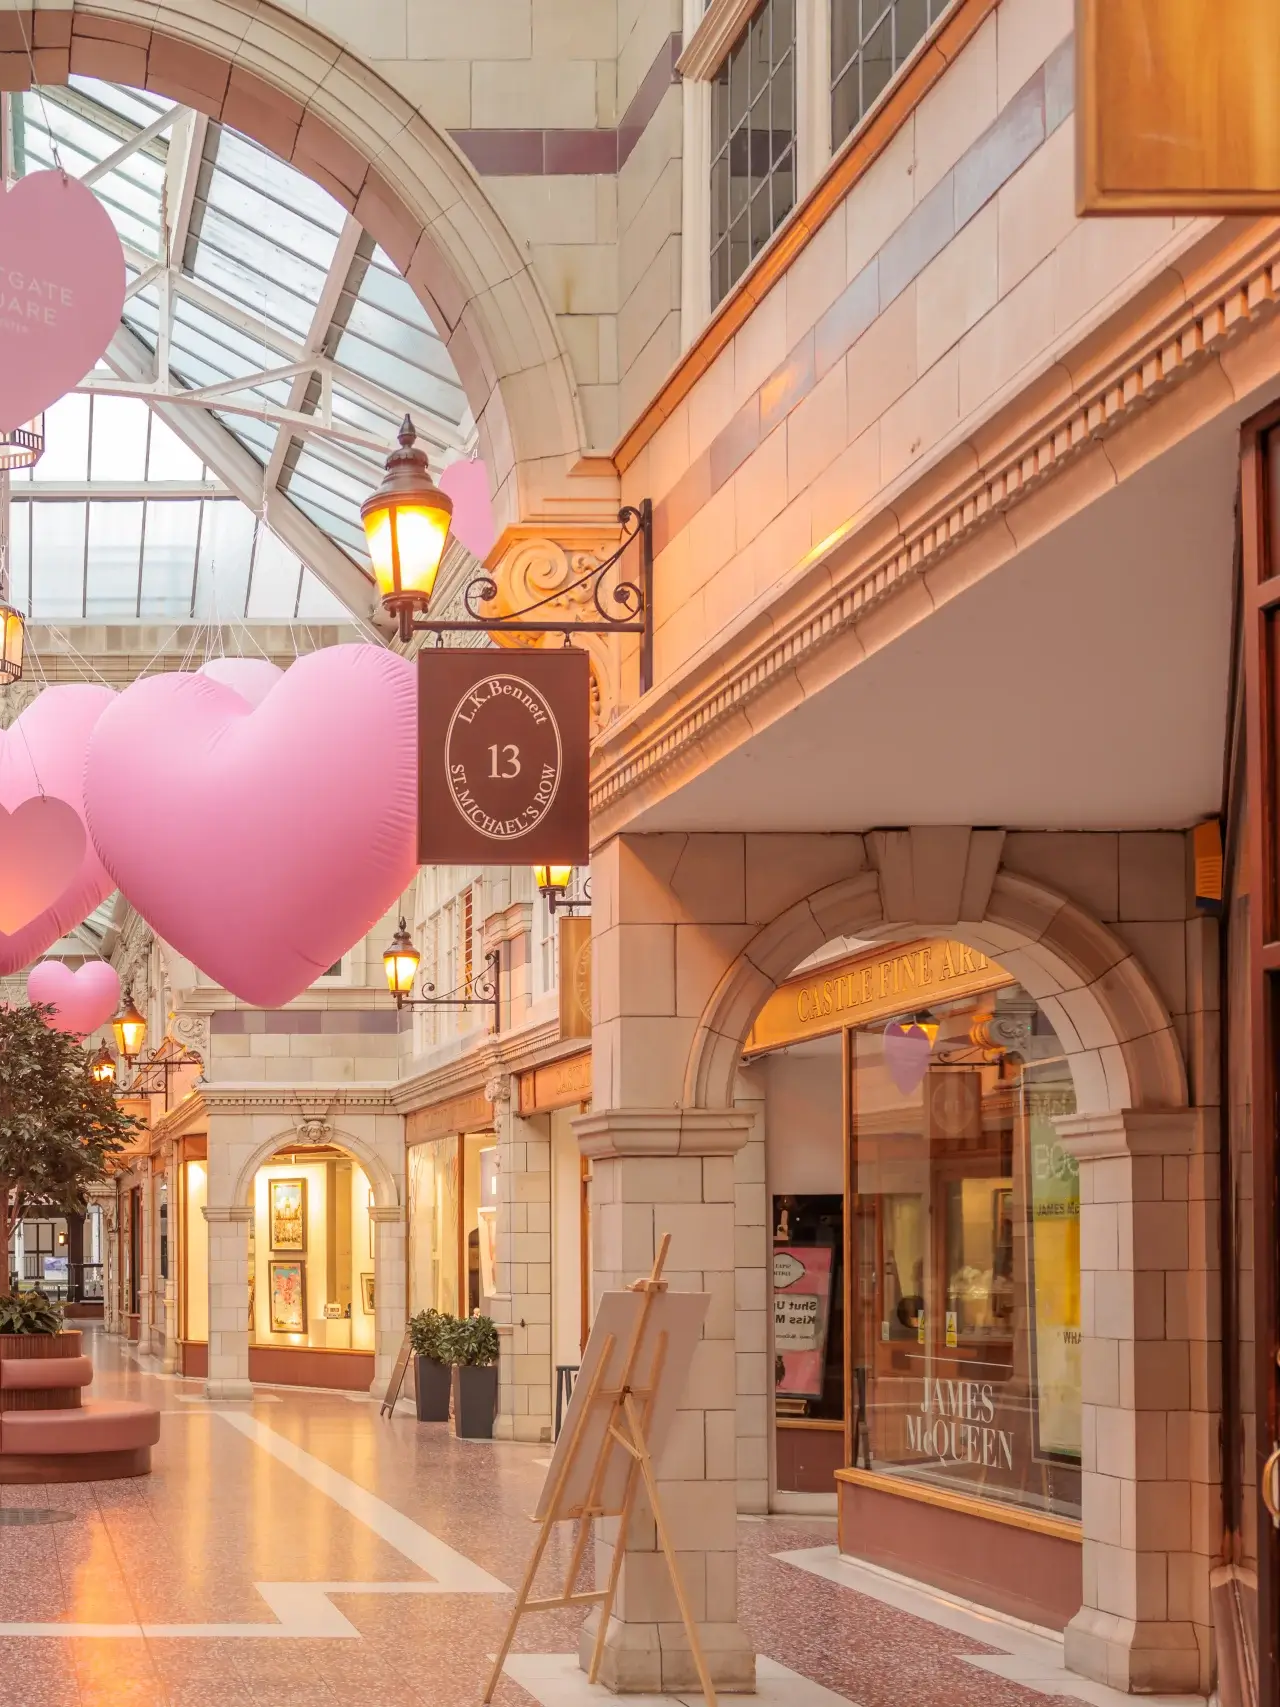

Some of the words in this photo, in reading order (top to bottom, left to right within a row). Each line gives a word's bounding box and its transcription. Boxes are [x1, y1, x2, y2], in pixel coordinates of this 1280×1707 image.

[487, 743, 522, 779] 13
[457, 788, 540, 835] MICHAEL'S
[533, 762, 557, 806] ROW
[797, 966, 873, 1023] CASTLE
[878, 947, 933, 999] FINE
[1037, 1203, 1065, 1217] JAMES
[920, 1376, 994, 1424] JAMES
[906, 1414, 1015, 1471] McQUEEN
